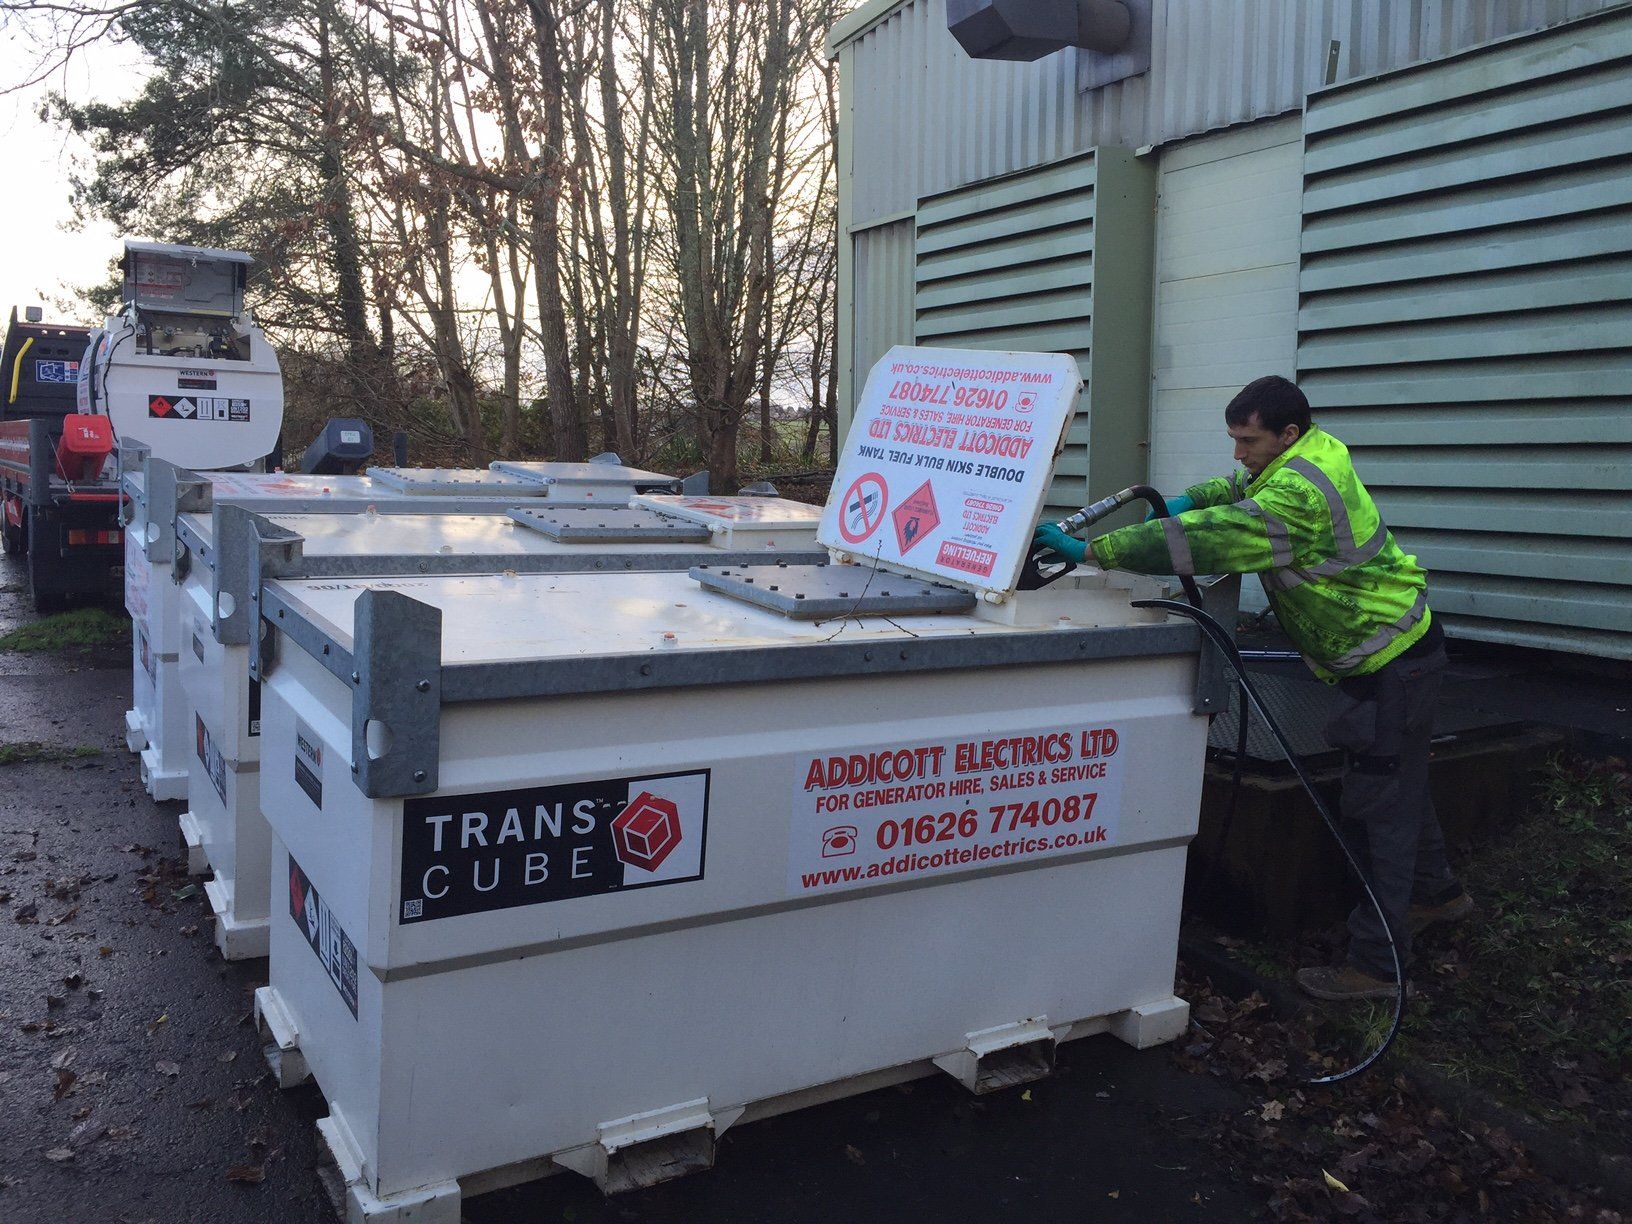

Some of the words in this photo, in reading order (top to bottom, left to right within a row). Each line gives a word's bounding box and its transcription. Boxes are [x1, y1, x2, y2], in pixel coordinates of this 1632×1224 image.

[890, 363, 1052, 384] www.addicottelectrics.co.uk
[889, 380, 949, 405] 774087
[953, 387, 1009, 411] 01626
[880, 404, 911, 420] SERVICE
[913, 409, 919, 419] &
[919, 409, 944, 423] SALES
[869, 418, 891, 439] LTD
[965, 415, 1013, 431] GENERATOR
[1013, 420, 1034, 433] FOR
[893, 421, 957, 449] ELECTRICS
[958, 430, 1034, 459] ADDICOTT
[857, 445, 885, 463] TANK
[888, 449, 914, 465] FUEL
[915, 454, 945, 470] BULK
[945, 459, 975, 474] SKIN
[975, 463, 1025, 483] DOUBLE
[962, 510, 973, 520] LTD
[973, 512, 999, 524] ELECTRICS
[962, 521, 990, 534] ADDICOTT
[942, 543, 993, 565] REFUELLING
[940, 556, 988, 574] GENERATOR
[803, 746, 944, 793] ADDICOTT
[954, 732, 1073, 773] ELECTRICS
[1080, 728, 1118, 758] LTD
[816, 793, 849, 814] FOR
[853, 781, 945, 809] GENERATOR
[949, 777, 984, 796] HIRE,
[989, 770, 1035, 792] SALES
[1038, 771, 1047, 785] &
[1050, 763, 1107, 784] SERVICE
[426, 799, 597, 852] TRANS
[876, 808, 978, 850] 01626
[989, 792, 1099, 834] 774087
[801, 825, 1108, 889] www.addicottelectrics.co.uk
[422, 845, 594, 899] CUBE
